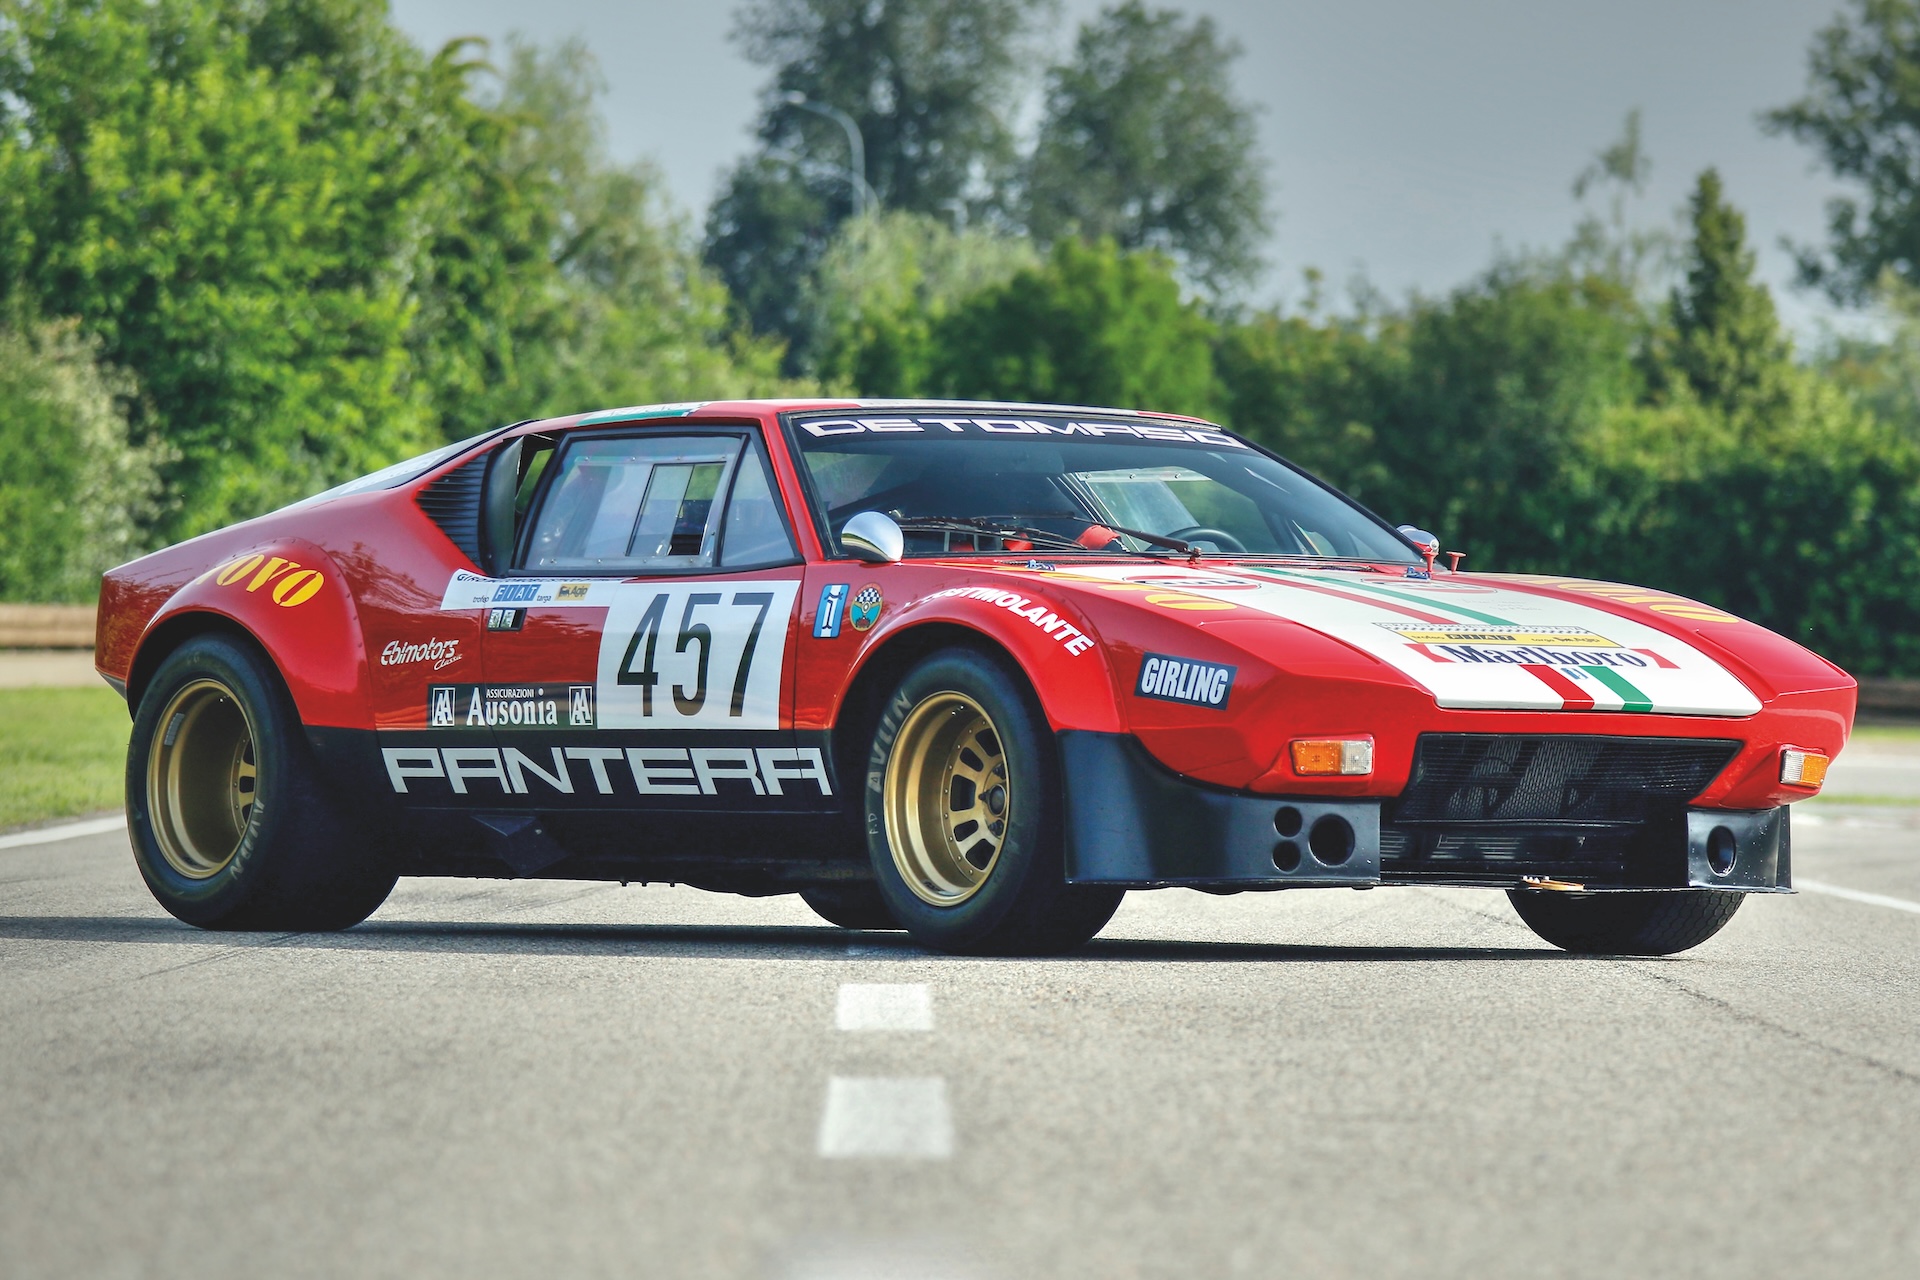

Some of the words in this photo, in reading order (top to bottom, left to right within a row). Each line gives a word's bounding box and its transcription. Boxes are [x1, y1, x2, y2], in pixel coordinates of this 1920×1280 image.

[493, 585, 541, 601] FIAT
[569, 586, 589, 598] Agip
[433, 653, 464, 672] Classic
[617, 592, 775, 718] 457
[1436, 645, 1647, 668] Marlboro
[485, 688, 535, 699] ASSICURAZIONI
[1141, 657, 1229, 705] GIRLING
[466, 687, 558, 726] Ausonia
[381, 747, 833, 796] PANTERA
